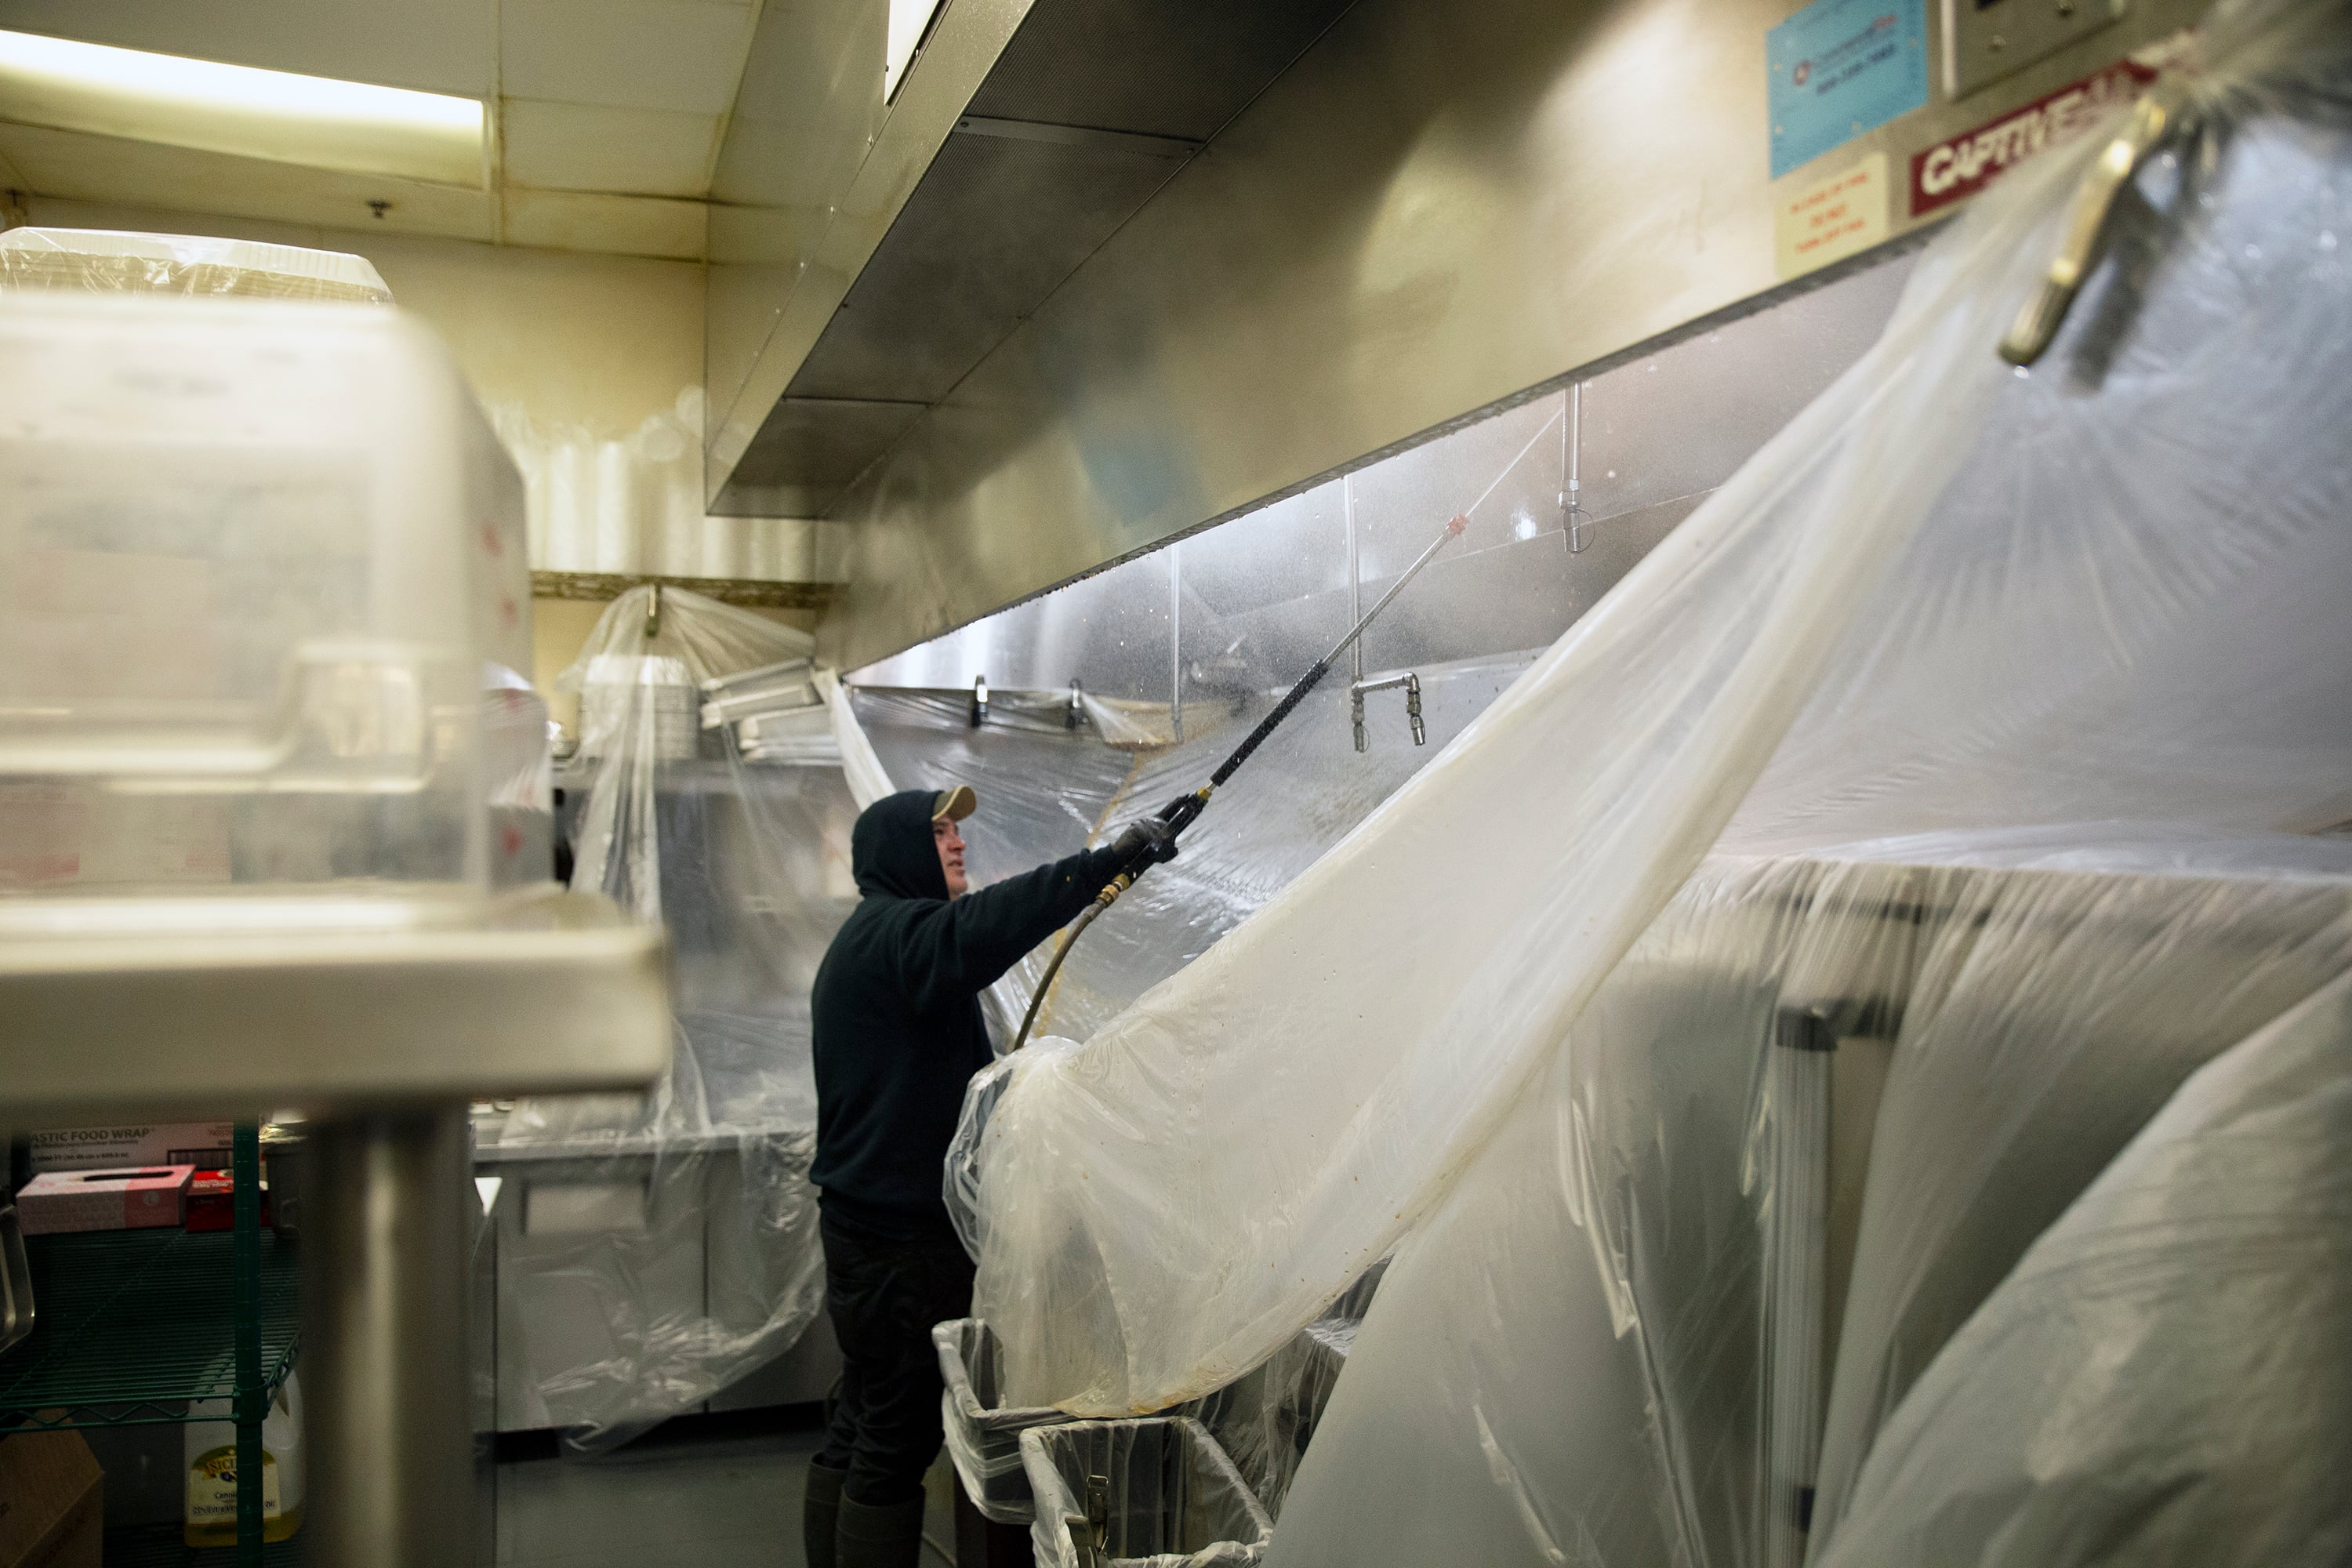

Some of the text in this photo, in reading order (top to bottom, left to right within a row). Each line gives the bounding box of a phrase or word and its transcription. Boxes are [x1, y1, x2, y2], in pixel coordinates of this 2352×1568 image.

[30, 1127, 149, 1143] ASTIC FOOD WRAP
